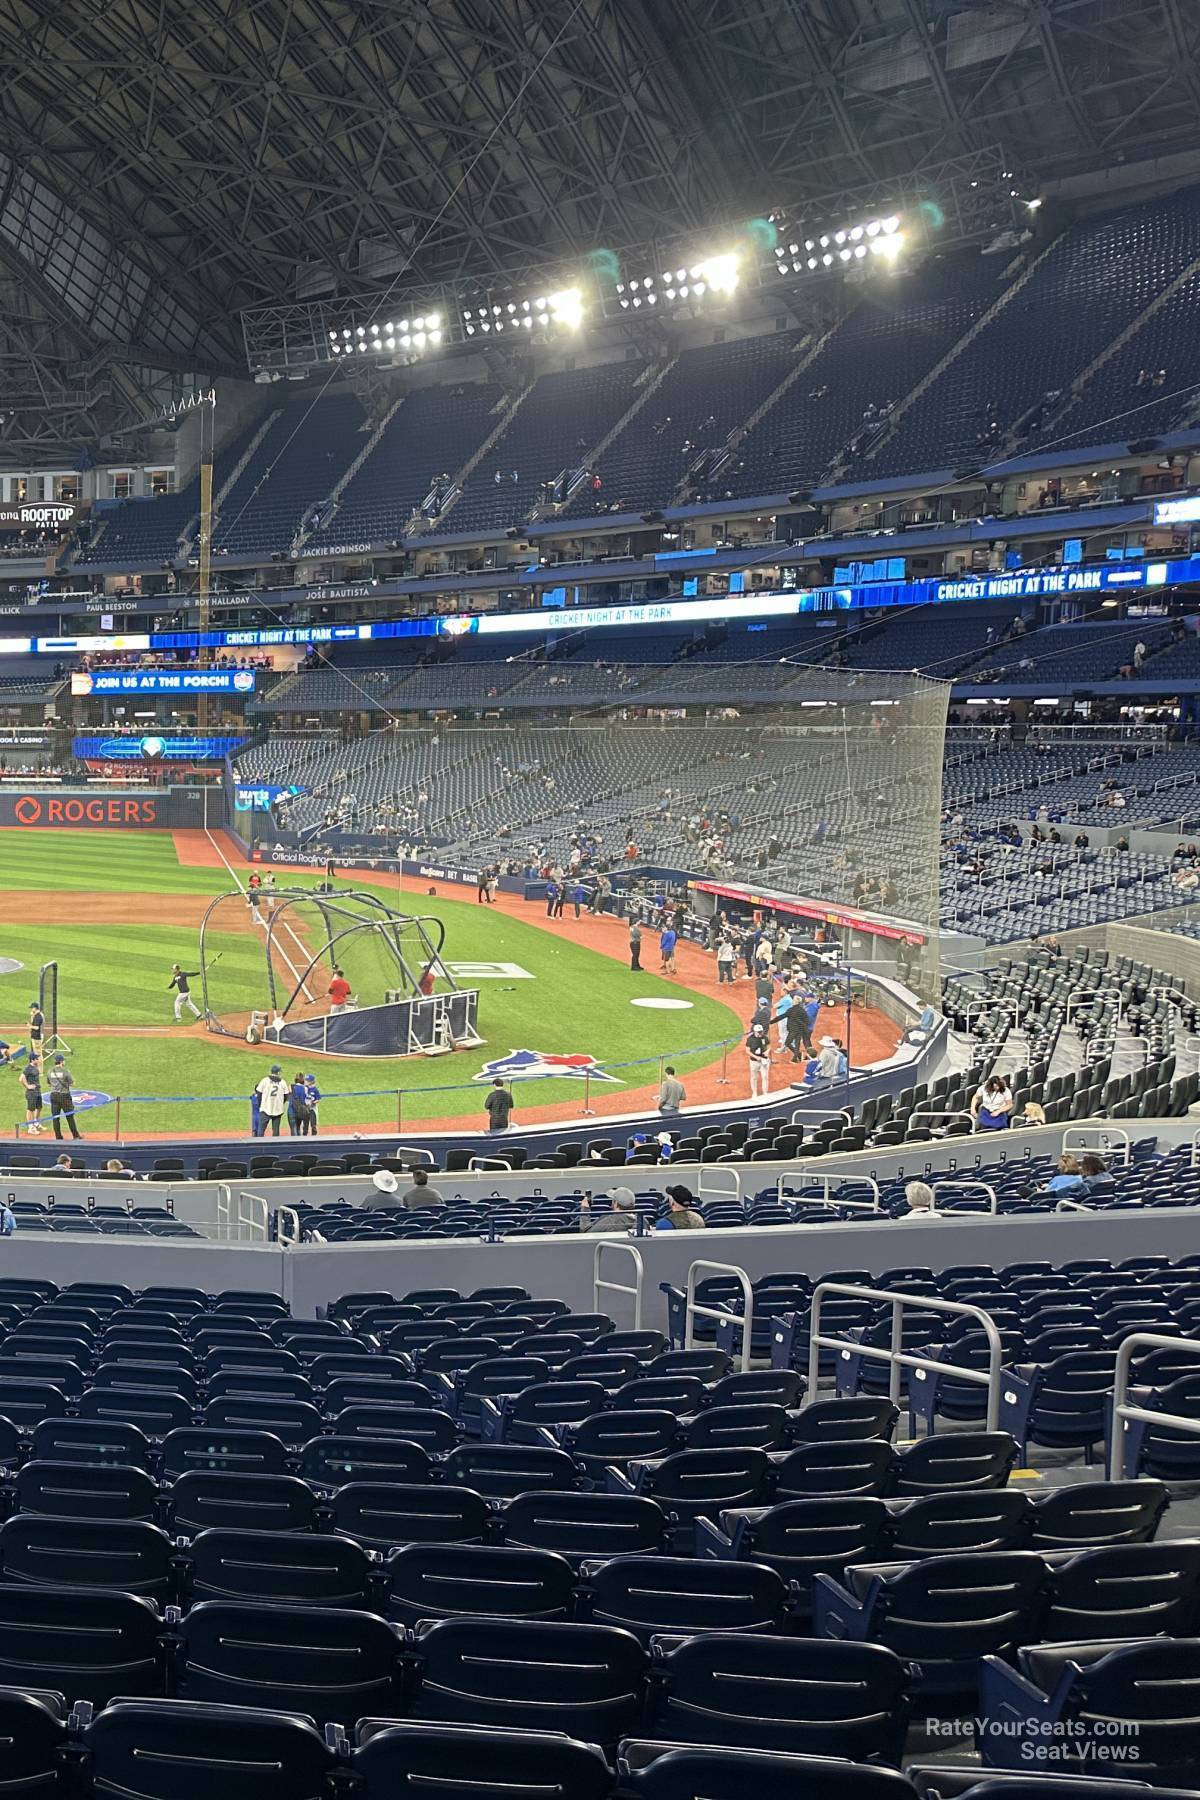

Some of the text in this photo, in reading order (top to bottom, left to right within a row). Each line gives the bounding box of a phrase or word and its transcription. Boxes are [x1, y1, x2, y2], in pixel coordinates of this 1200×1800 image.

[21, 507, 74, 521] ROOFTOP
[302, 544, 371, 557] JACKIE ROBINSON
[938, 581, 986, 600] CRICKET
[988, 579, 1023, 597] NIGHT
[1025, 577, 1041, 593] AT
[1043, 575, 1065, 591] THE
[1068, 572, 1101, 589] PARK
[330, 588, 369, 598] BAUTISTA
[86, 602, 137, 611] PAUL BEESTON
[211, 597, 250, 606] HALLADAY
[549, 607, 672, 625] CRICKET NIGHT AT THE PARK
[226, 632, 258, 644] CRICKET
[259, 631, 283, 643] NIGHT
[284, 630, 294, 642] AT
[295, 629, 310, 641] THE
[311, 628, 332, 640] PARK
[96, 675, 229, 689] JOIN US AT THE PORCH!
[48, 800, 156, 823] ROGERS
[272, 852, 297, 862] Official
[298, 853, 328, 865] Roofing
[447, 870, 458, 880] BET
[270, 1085, 279, 1097] 2
